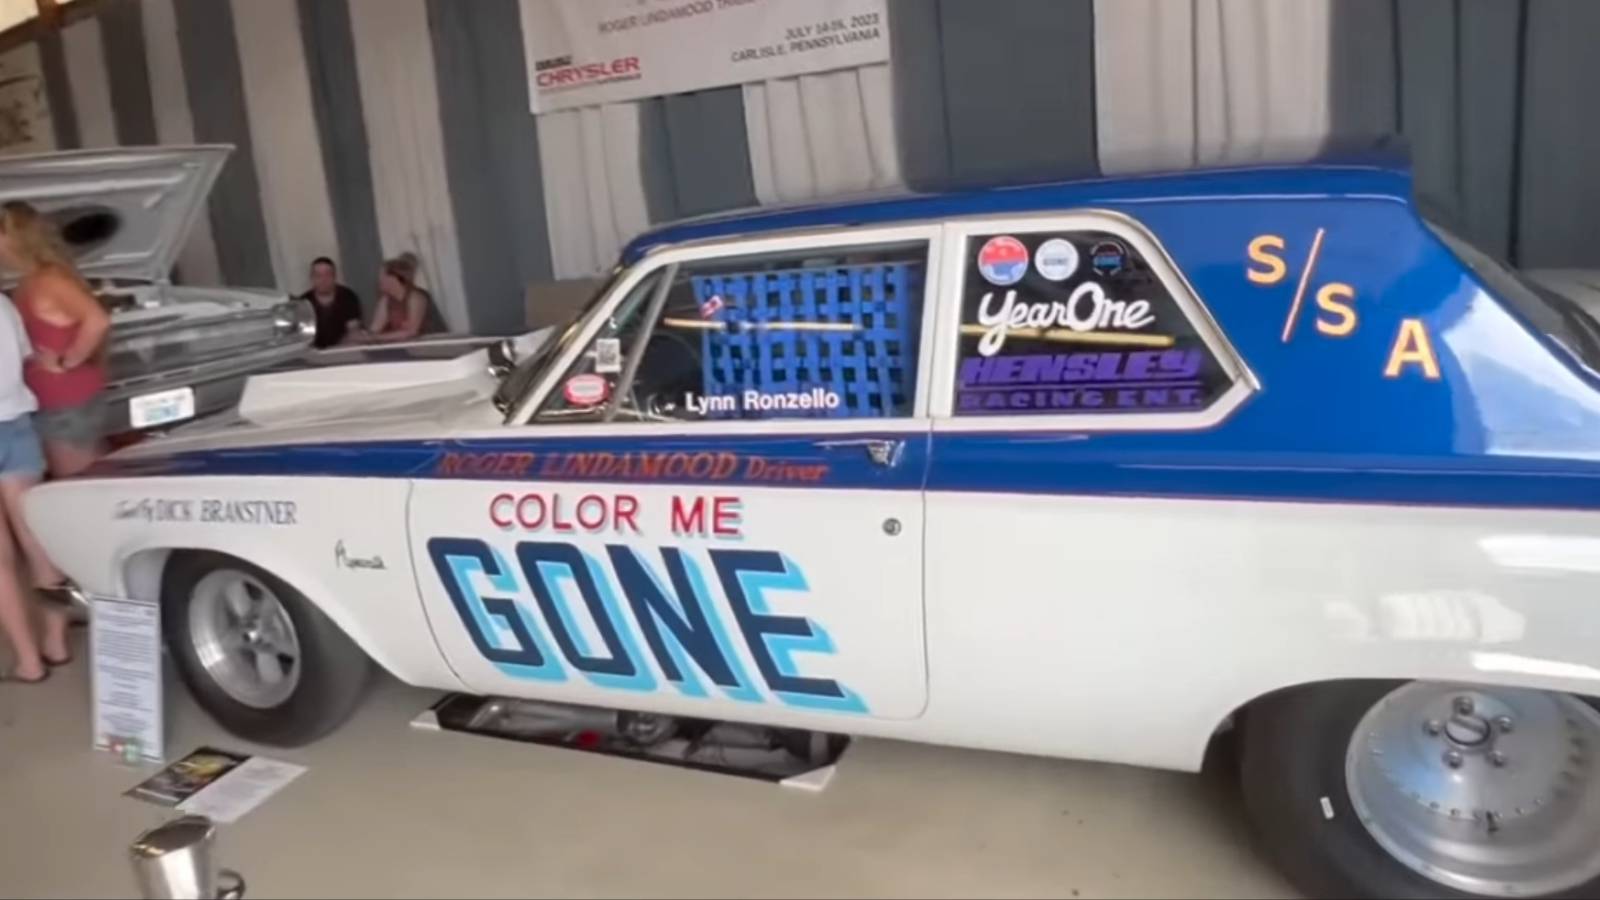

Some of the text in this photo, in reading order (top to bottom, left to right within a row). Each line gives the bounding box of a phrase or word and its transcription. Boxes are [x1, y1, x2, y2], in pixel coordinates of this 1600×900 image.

[785, 25, 812, 41] JULY
[851, 12, 880, 28] 2023
[789, 27, 880, 52] PENNSYLVANIA
[536, 56, 640, 88] CHRYSLER
[1384, 317, 1441, 379] A
[960, 349, 1202, 387] HENSLEY
[685, 387, 840, 415] Lynn Ronzello
[958, 388, 1105, 411] RACING
[435, 451, 830, 482] ROGER LINDAMOOD Driver
[199, 498, 298, 526] BRANSTNER
[488, 493, 743, 537] COLOR ME
[427, 537, 870, 714] GONE
